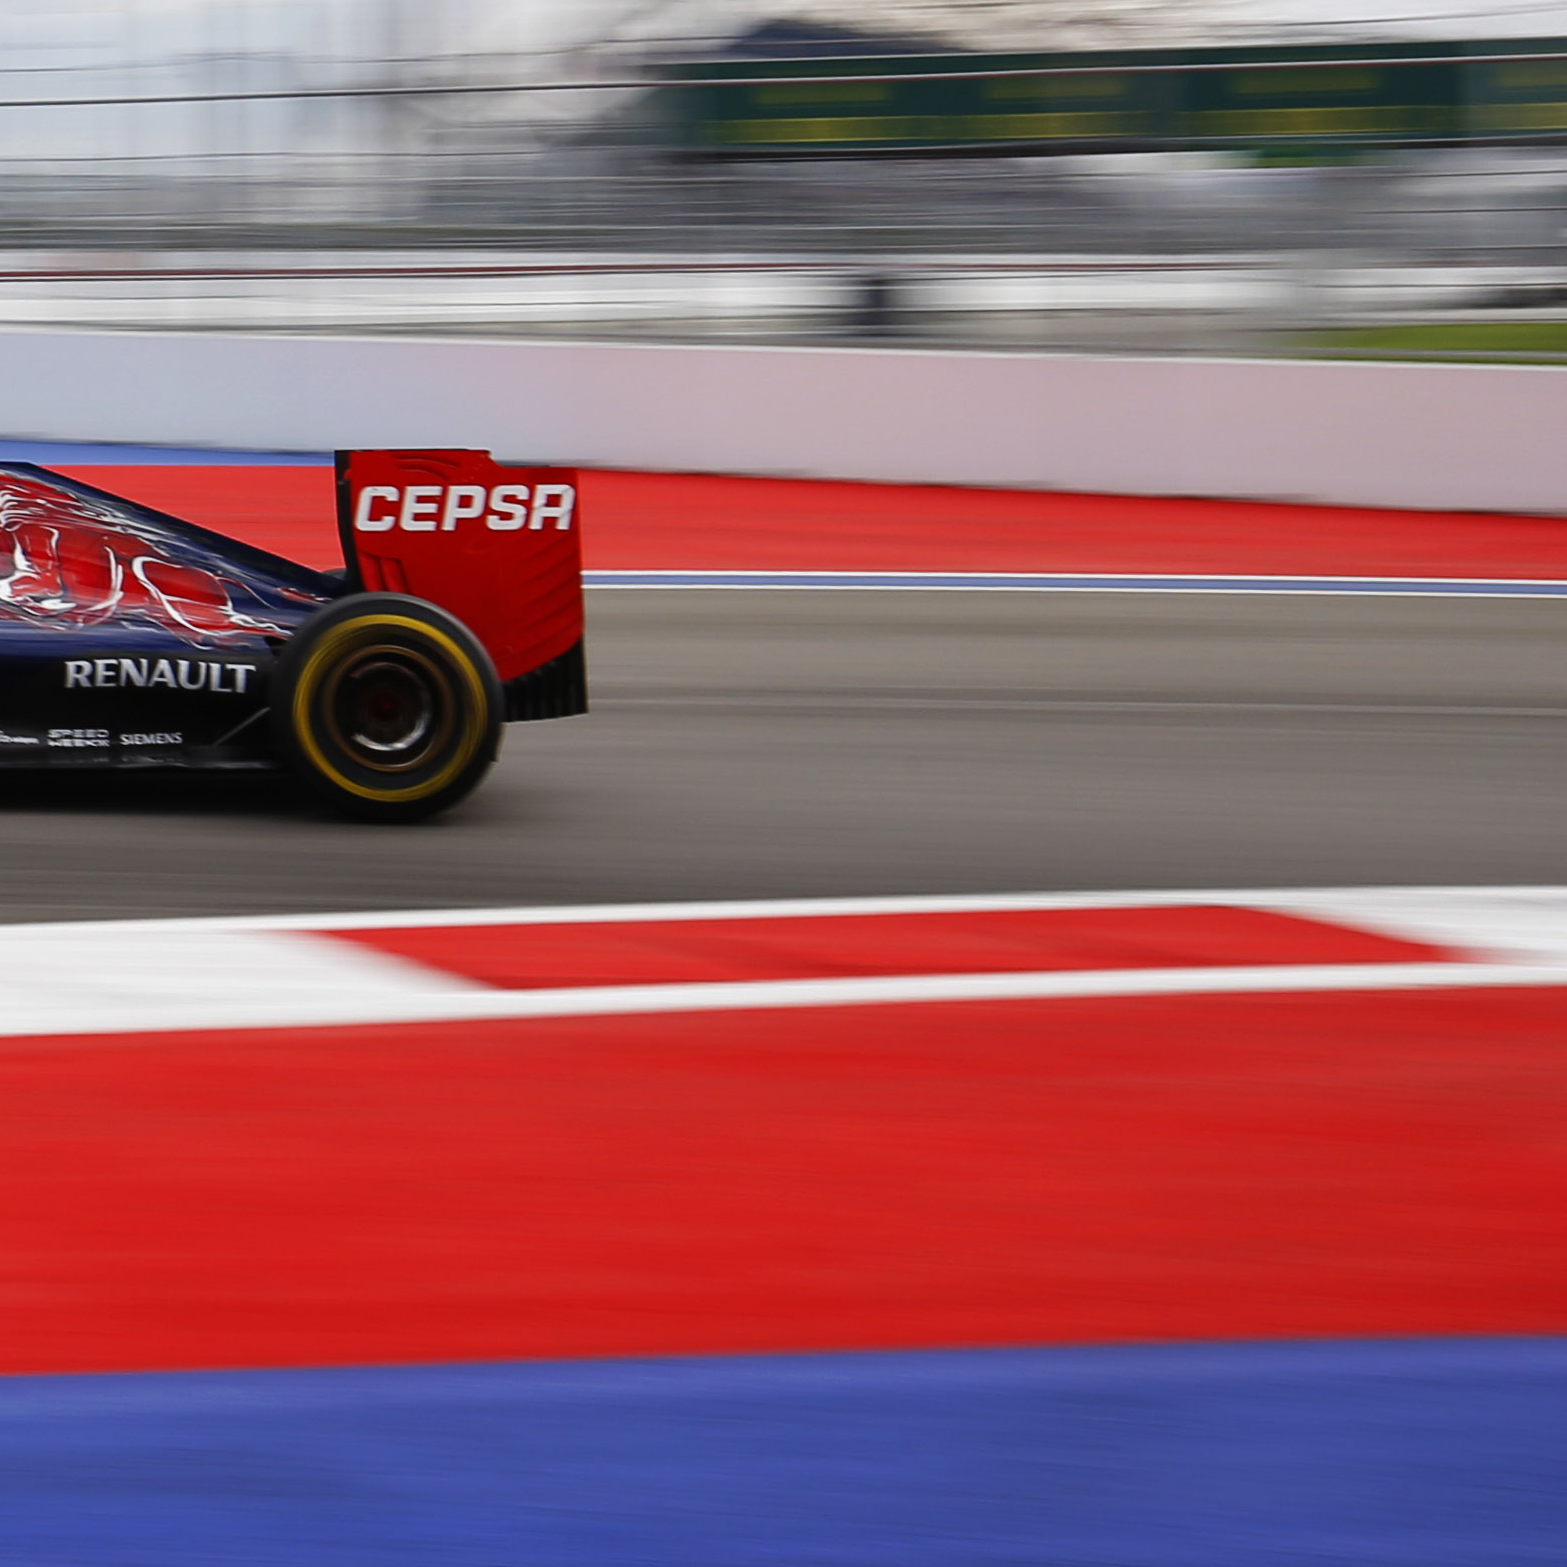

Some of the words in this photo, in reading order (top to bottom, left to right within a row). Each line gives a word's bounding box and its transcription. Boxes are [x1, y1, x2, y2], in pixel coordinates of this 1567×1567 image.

[354, 484, 576, 532] CEPSA
[64, 658, 256, 694] RENAULT
[120, 732, 183, 745] SIEMENS
